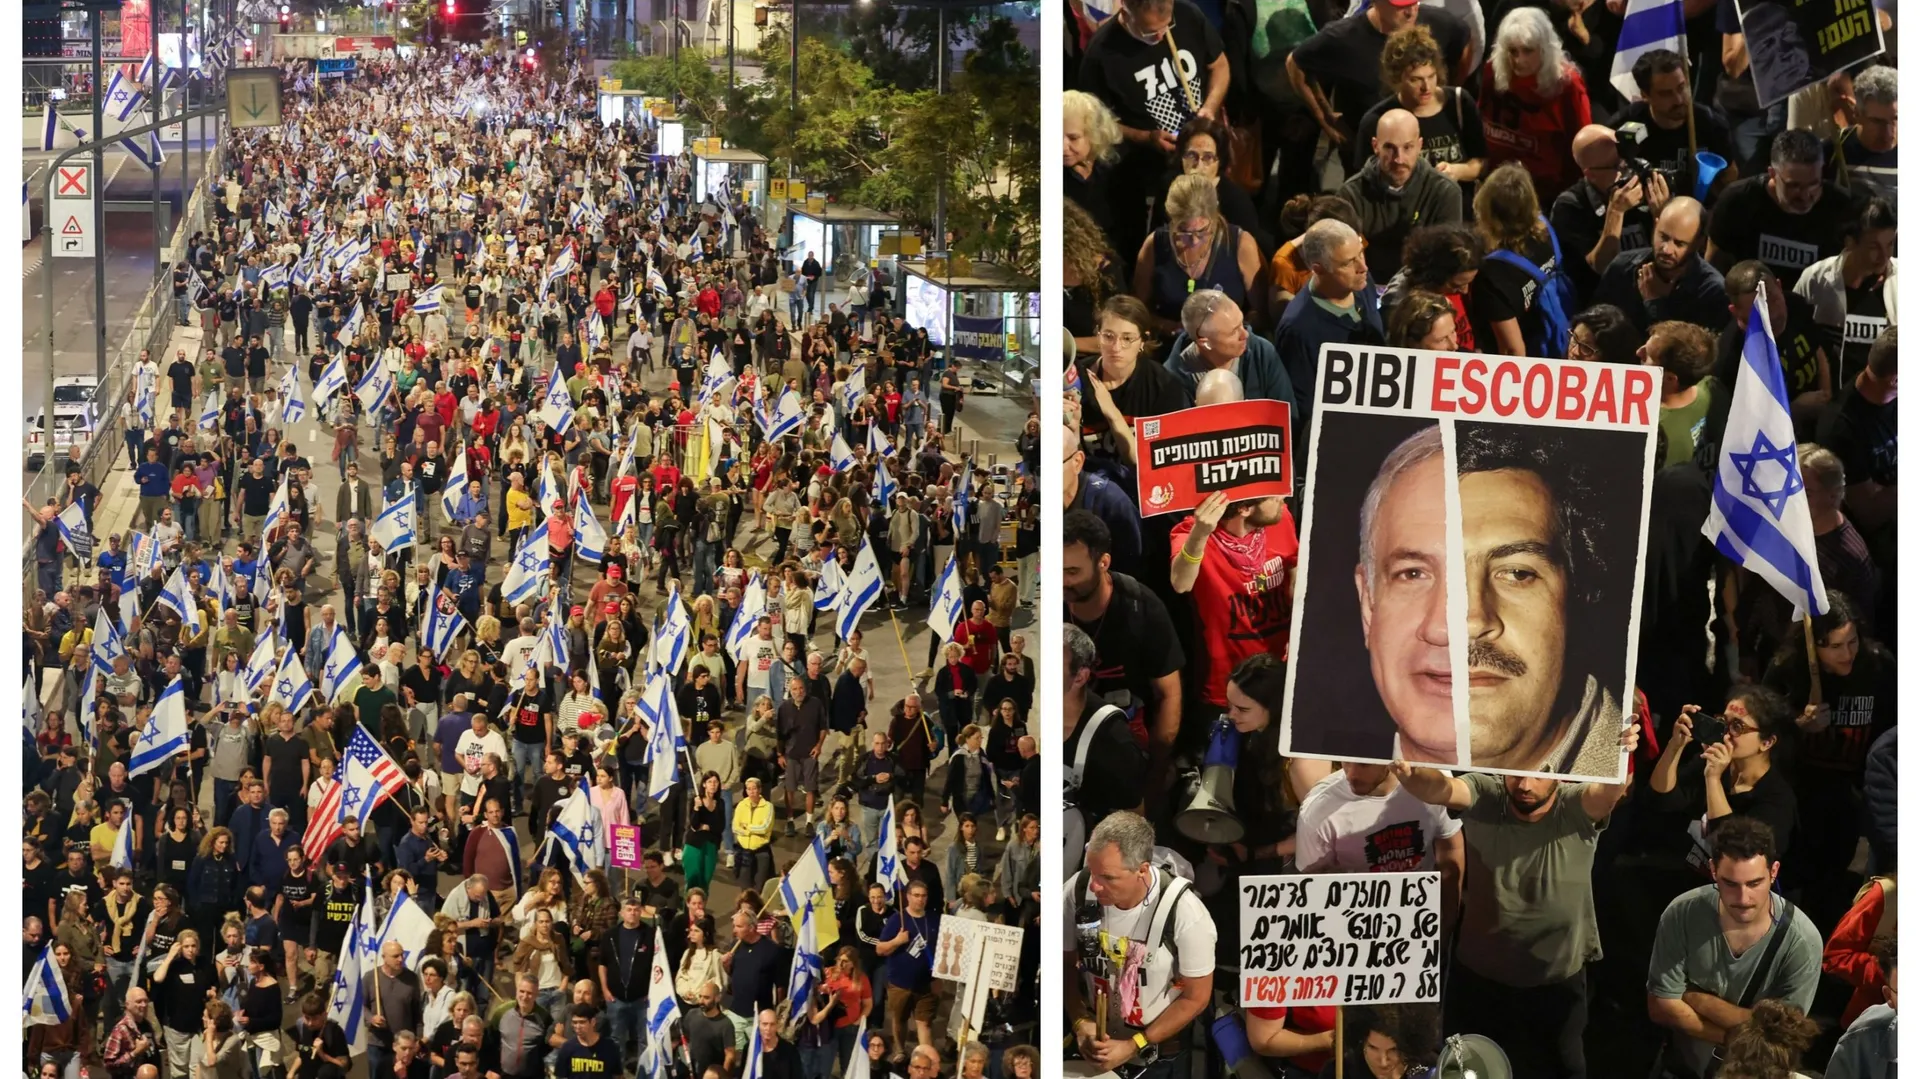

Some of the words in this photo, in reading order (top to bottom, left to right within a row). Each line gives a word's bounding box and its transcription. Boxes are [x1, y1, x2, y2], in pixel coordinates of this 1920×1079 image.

[1817, 9, 1871, 55] העם!
[1134, 49, 1197, 100] 7.10
[1322, 350, 1417, 409] BIBI
[1430, 357, 1654, 425] ESCOBAR
[1154, 439, 1219, 466] וחטופים
[1222, 433, 1280, 455] חטופות
[1202, 456, 1281, 484] תחילה!
[1377, 847, 1415, 864] HOME
[1243, 878, 1313, 908] לדיבור
[1324, 879, 1391, 909] חוזרים
[1250, 912, 1325, 941] אומרים
[1410, 908, 1439, 939] של
[1240, 942, 1298, 971] שנדבר
[1302, 937, 1359, 970] רוצים
[1366, 938, 1411, 968] שלא
[1421, 940, 1440, 968] מי
[1244, 976, 1290, 1003] עכשיו
[1292, 975, 1339, 1000] הדחה
[1389, 972, 1406, 998] ה
[1415, 969, 1440, 999] על
